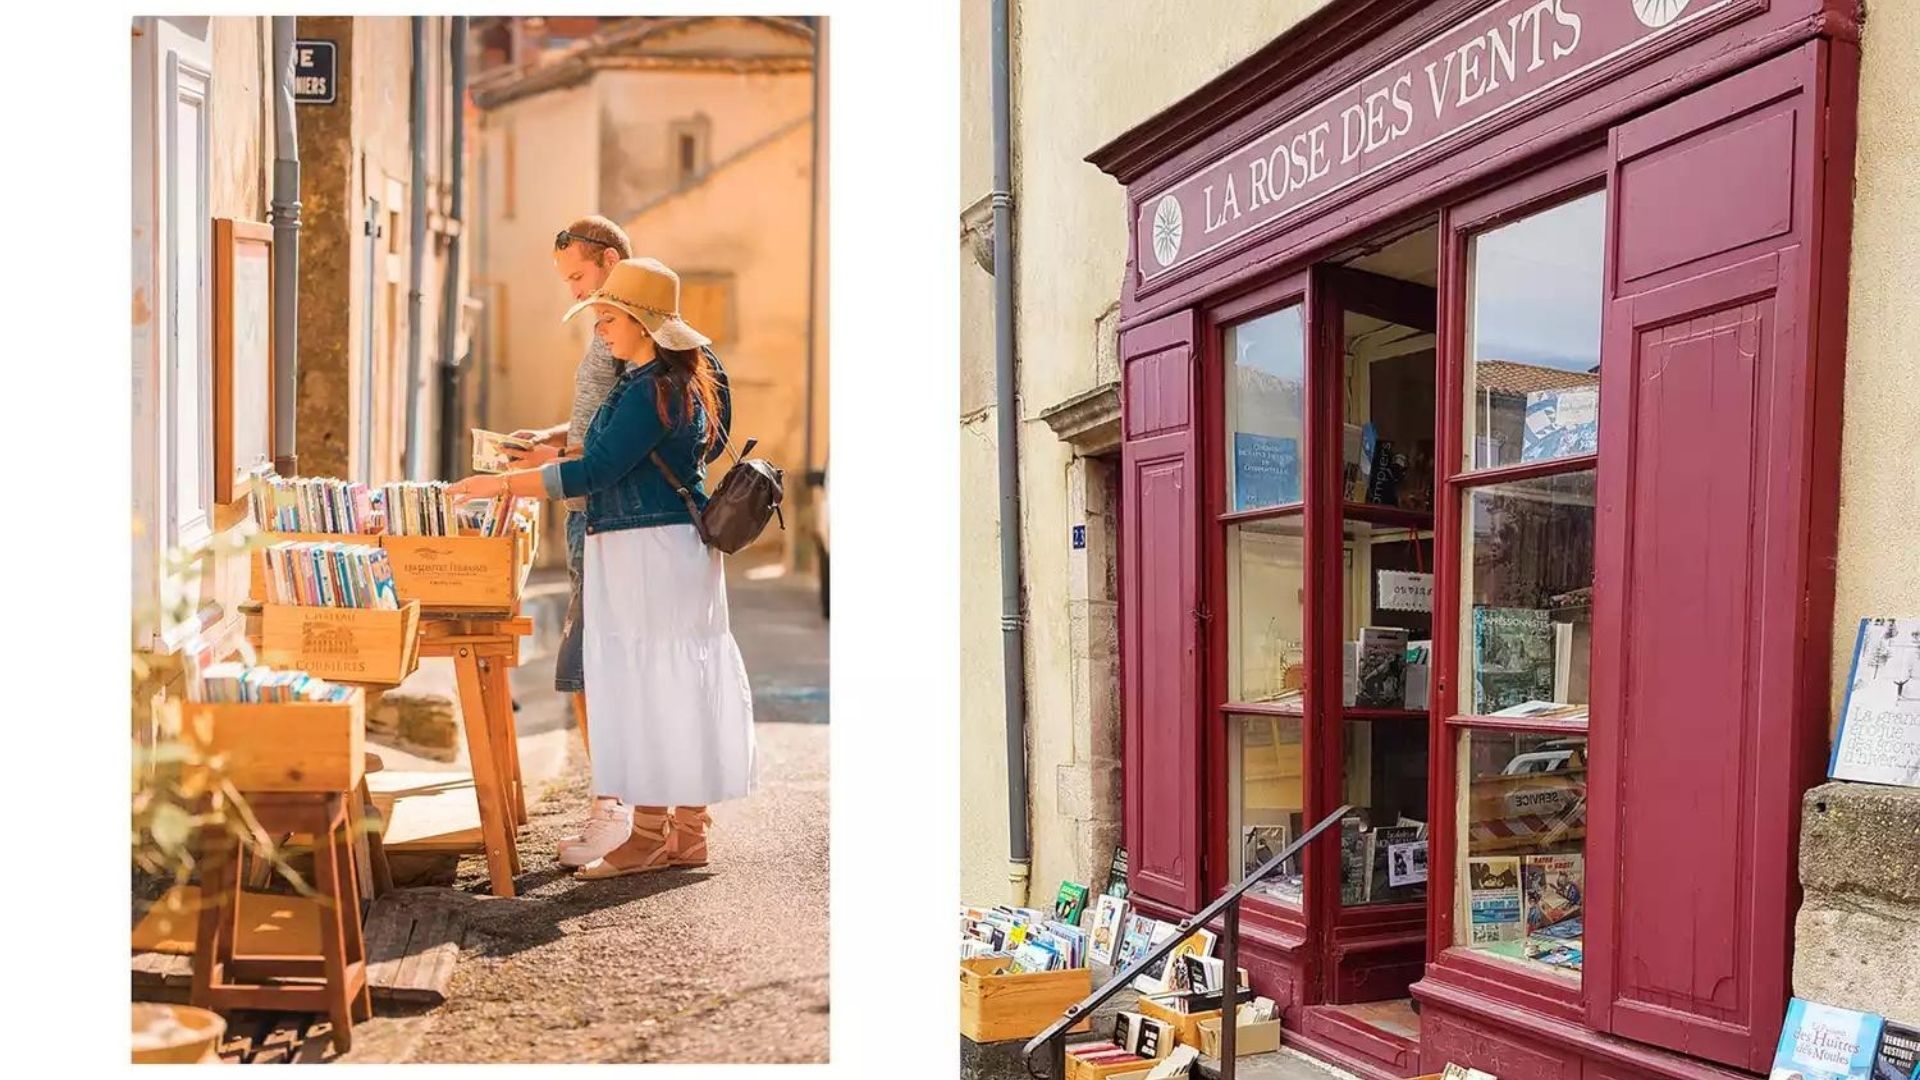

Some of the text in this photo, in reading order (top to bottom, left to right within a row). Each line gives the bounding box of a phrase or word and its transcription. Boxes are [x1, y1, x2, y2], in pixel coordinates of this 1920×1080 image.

[1203, 0, 1582, 234] LA ROSE DES VENTS
